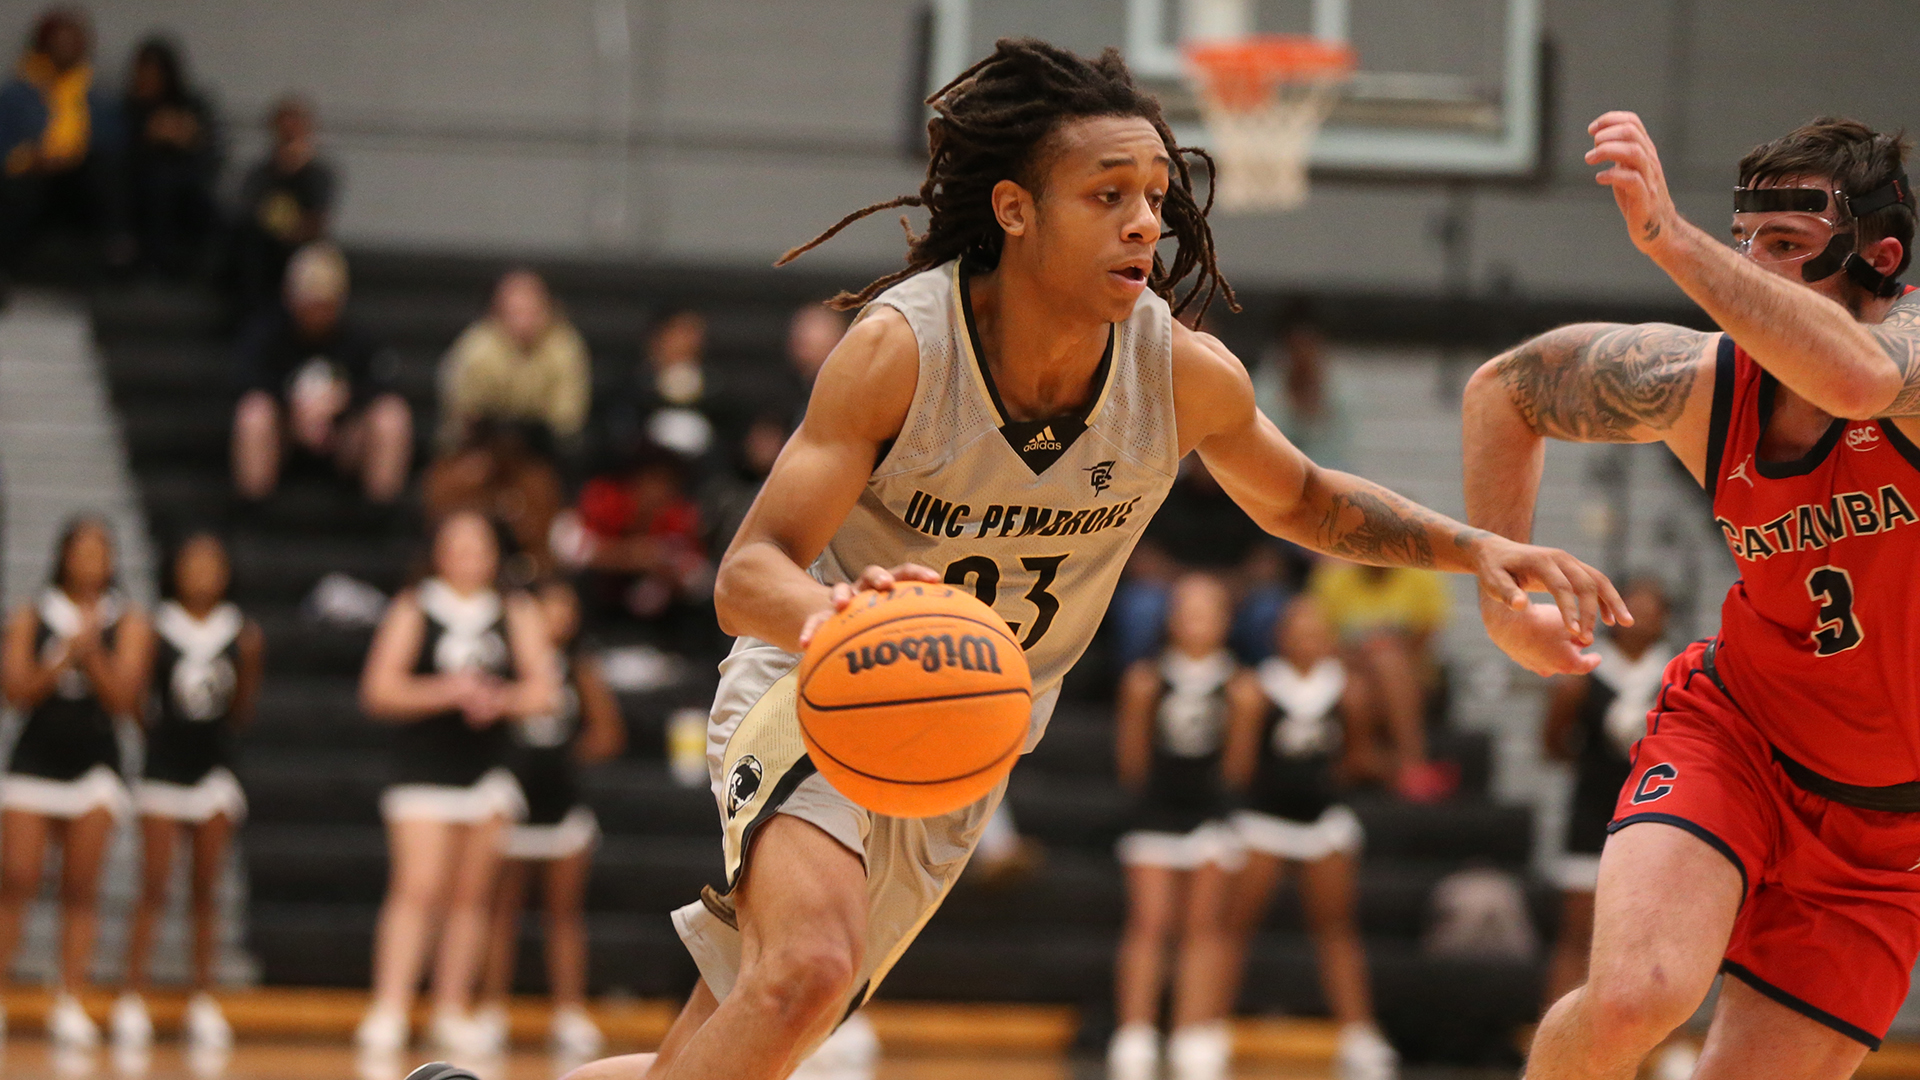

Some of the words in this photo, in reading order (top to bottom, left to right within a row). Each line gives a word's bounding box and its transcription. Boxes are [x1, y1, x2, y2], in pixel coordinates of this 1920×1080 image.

[1023, 440, 1062, 452] adidas
[1847, 426, 1879, 446] SAC
[904, 490, 971, 538] UNC
[974, 496, 1142, 538] PEMBROKE
[1805, 565, 1864, 657] 3
[846, 634, 1002, 674] Wilson
[1631, 763, 1678, 806] C
